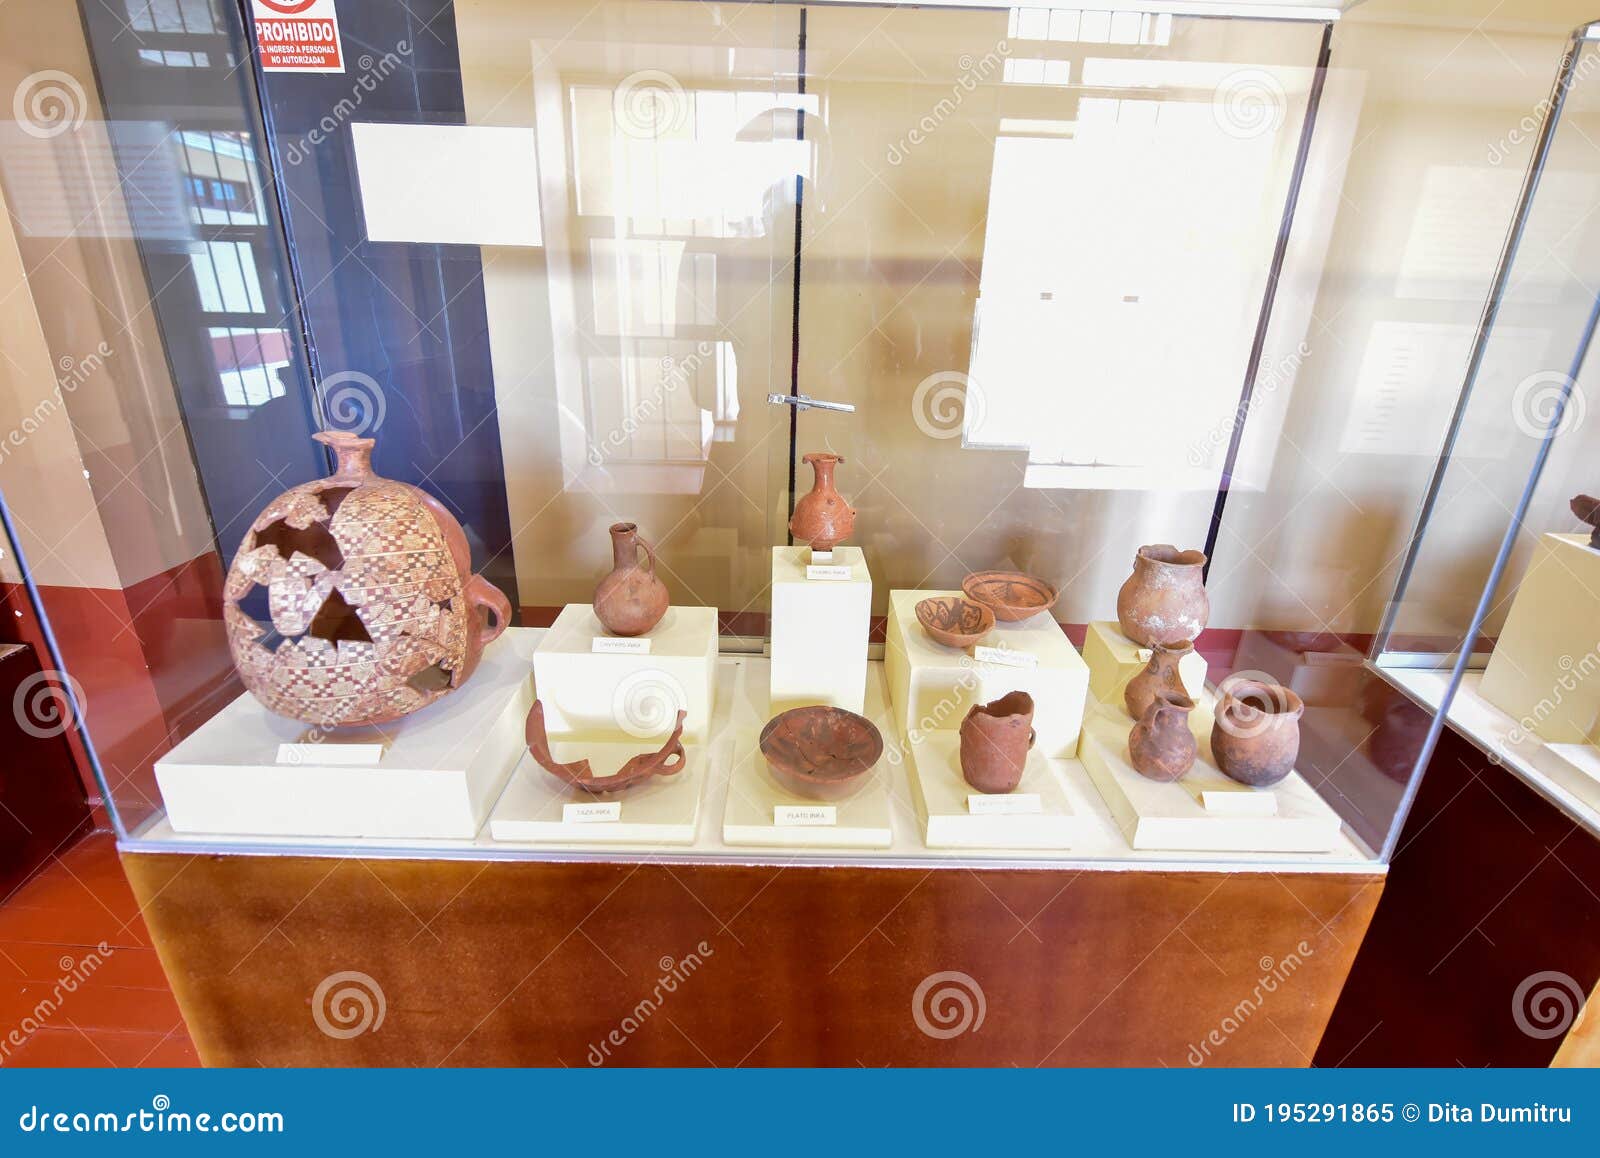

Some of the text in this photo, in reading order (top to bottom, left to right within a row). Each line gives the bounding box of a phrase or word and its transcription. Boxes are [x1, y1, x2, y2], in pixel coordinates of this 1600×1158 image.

[255, 22, 334, 42] PROHIBIDO
[267, 45, 295, 53] INGRESO
[302, 45, 335, 53] PERSONAS
[271, 56, 325, 64] NO AUTORIZADAS
